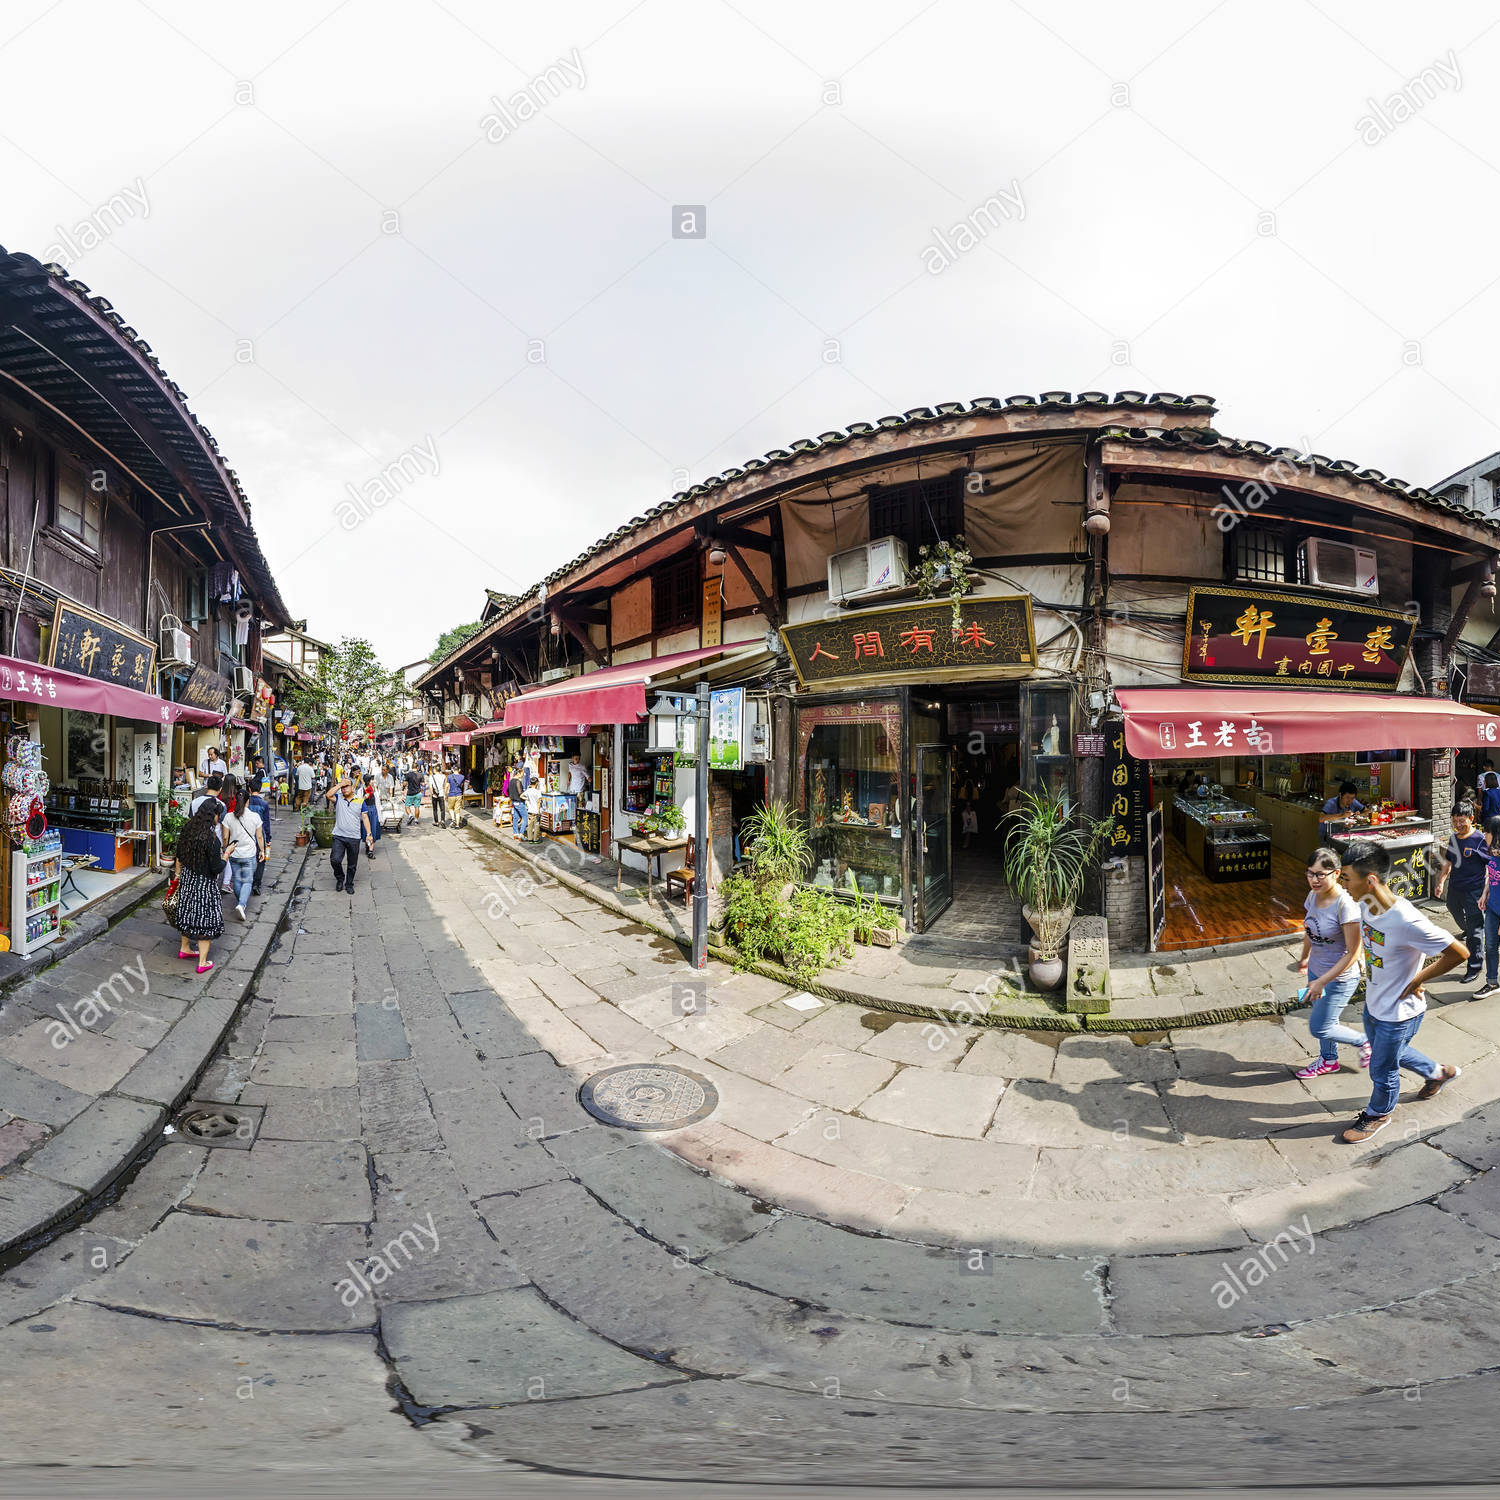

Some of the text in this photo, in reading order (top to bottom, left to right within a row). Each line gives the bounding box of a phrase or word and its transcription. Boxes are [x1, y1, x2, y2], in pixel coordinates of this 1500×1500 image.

[16, 670, 57, 699] 王老吉
[1184, 719, 1265, 749] 王老吉
[1386, 872, 1410, 887] pecial
